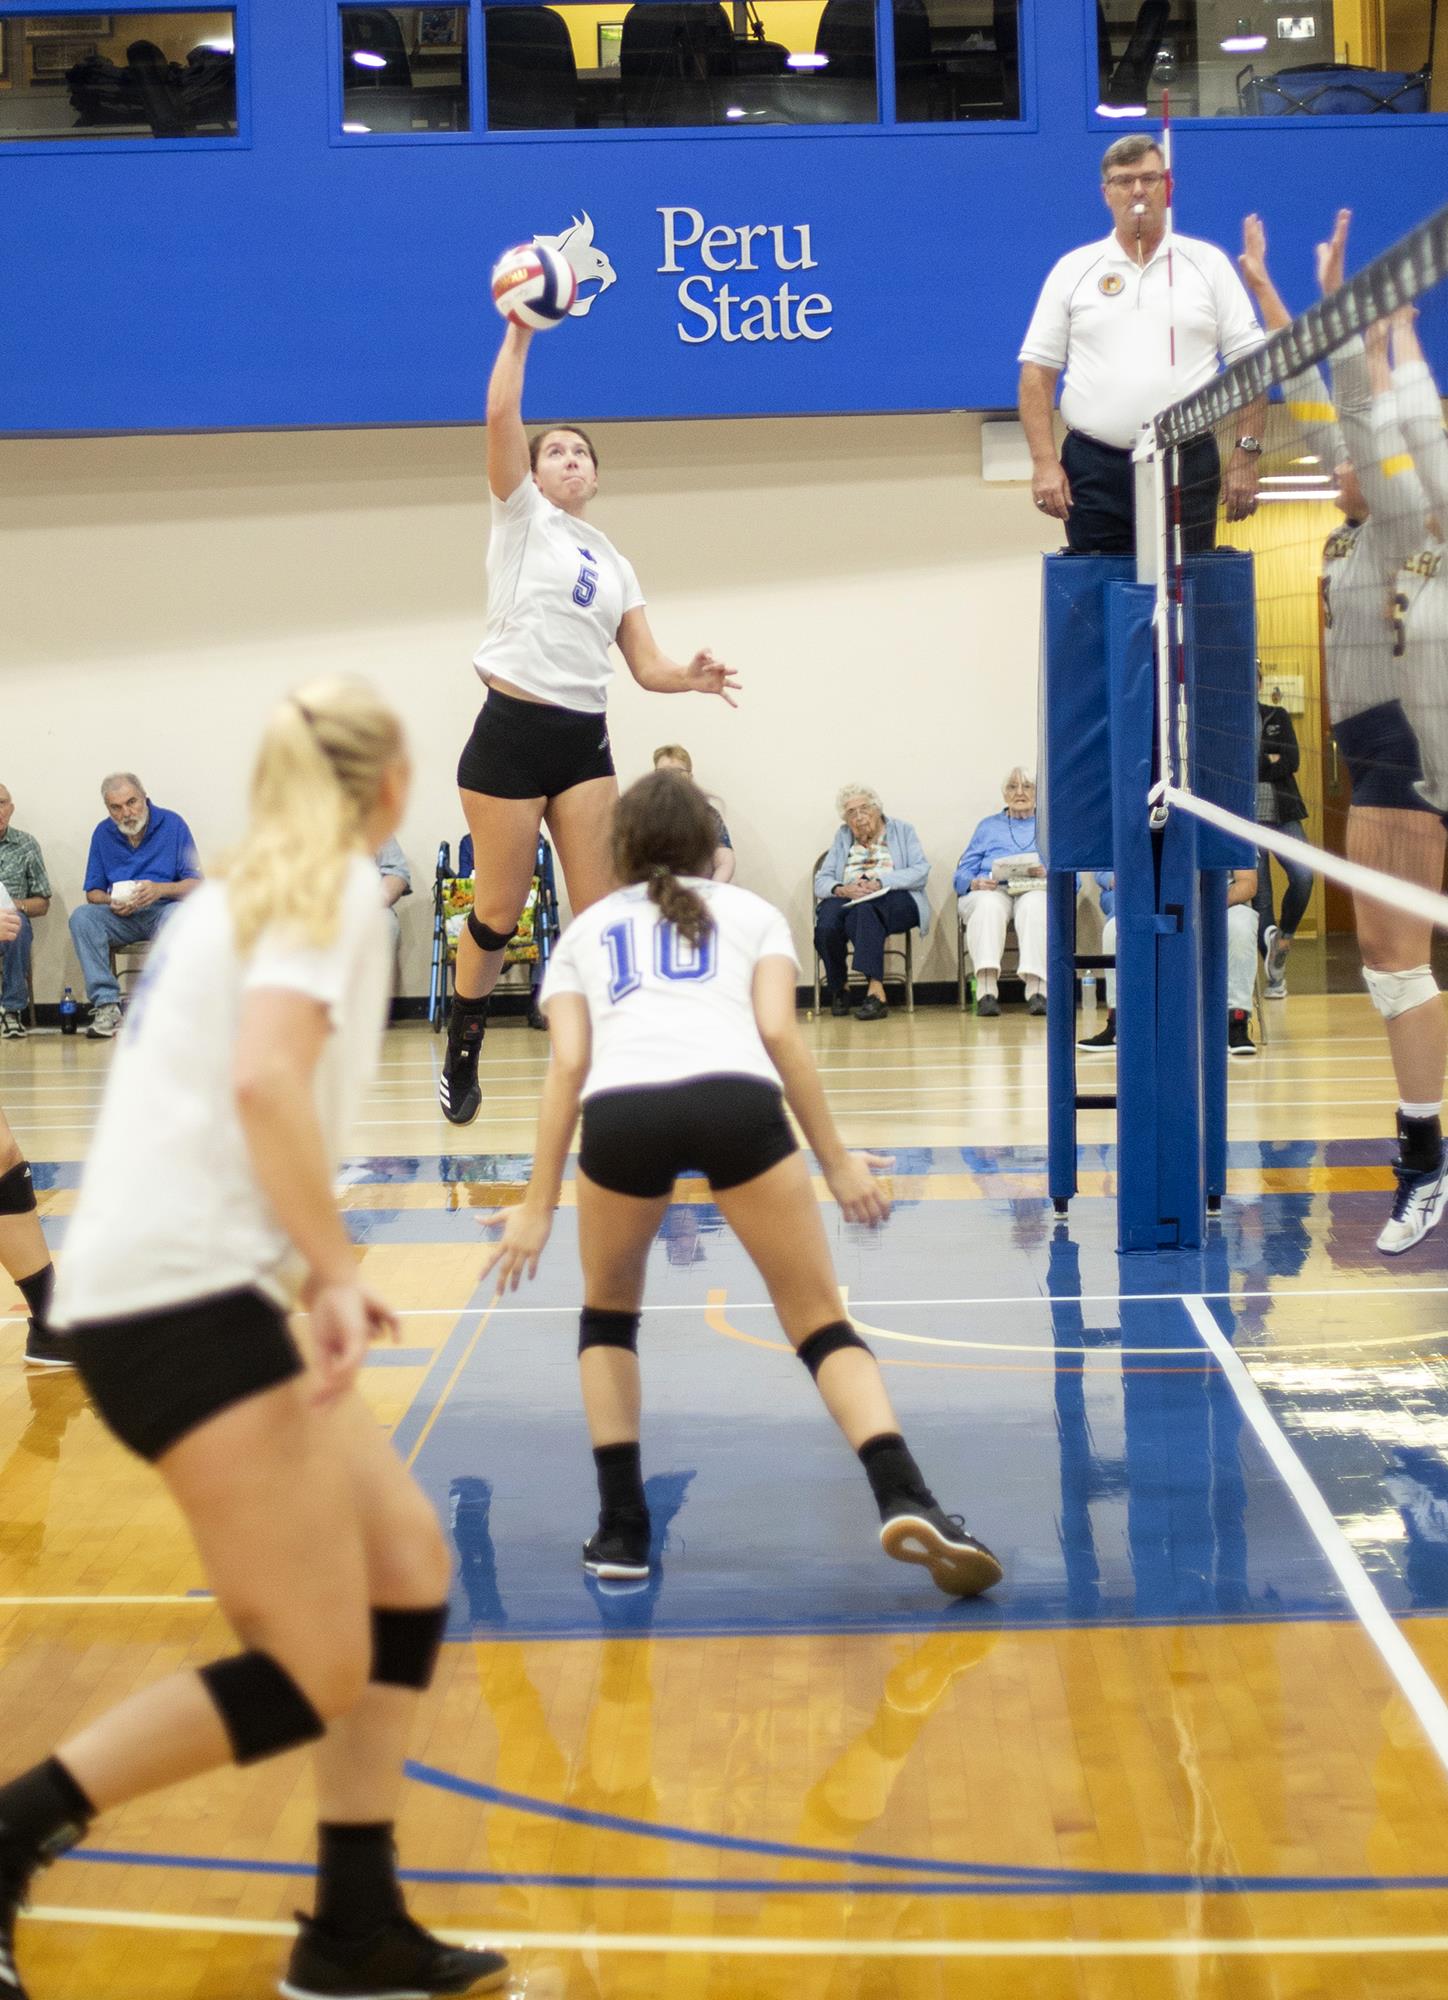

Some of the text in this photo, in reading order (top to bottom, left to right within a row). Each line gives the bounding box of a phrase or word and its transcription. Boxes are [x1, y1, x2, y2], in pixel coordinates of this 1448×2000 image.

[656, 207, 818, 272] Peru
[677, 275, 833, 343] State
[572, 564, 599, 608] 5
[600, 917, 718, 1005] 10
